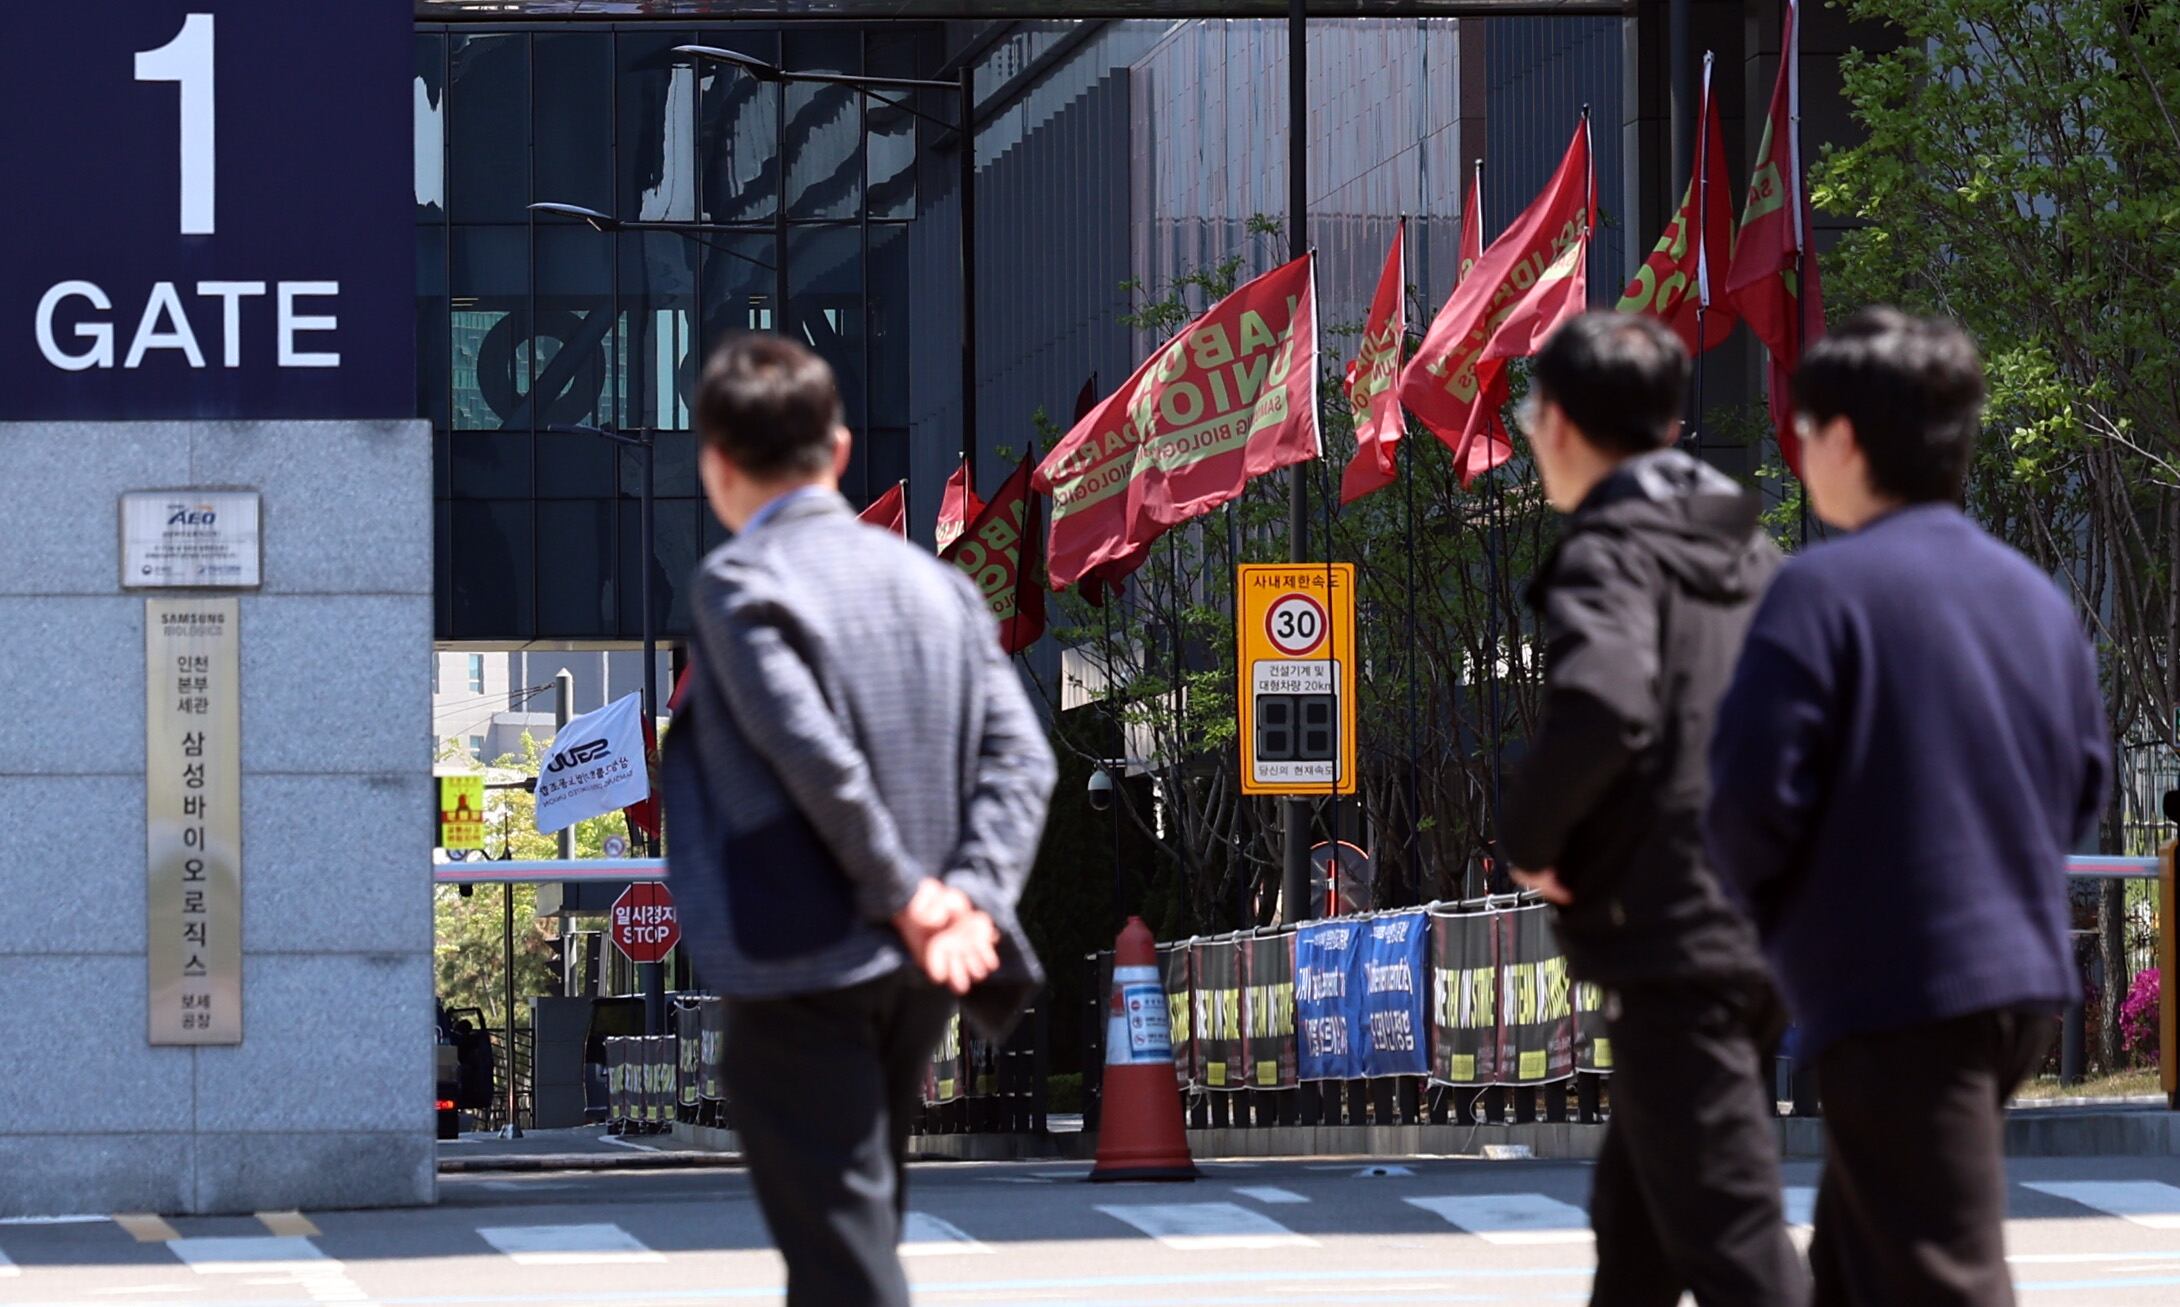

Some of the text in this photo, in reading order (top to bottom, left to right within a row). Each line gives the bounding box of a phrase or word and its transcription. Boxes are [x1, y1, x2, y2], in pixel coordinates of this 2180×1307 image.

[134, 13, 215, 234] 1
[35, 280, 340, 371] GATE
[167, 511, 216, 525] AEO
[161, 613, 225, 624] SAMSUNG
[1277, 610, 1315, 638] 30
[177, 655, 208, 673] 인천
[1270, 665, 1325, 677] 건설기계 및
[177, 677, 208, 693] 본부
[1260, 680, 1300, 692] 대형차량
[177, 697, 208, 714] 세관
[1259, 765, 1288, 776] 당신의
[182, 731, 207, 976] 삼성바이오로직스
[623, 926, 669, 944] STOP
